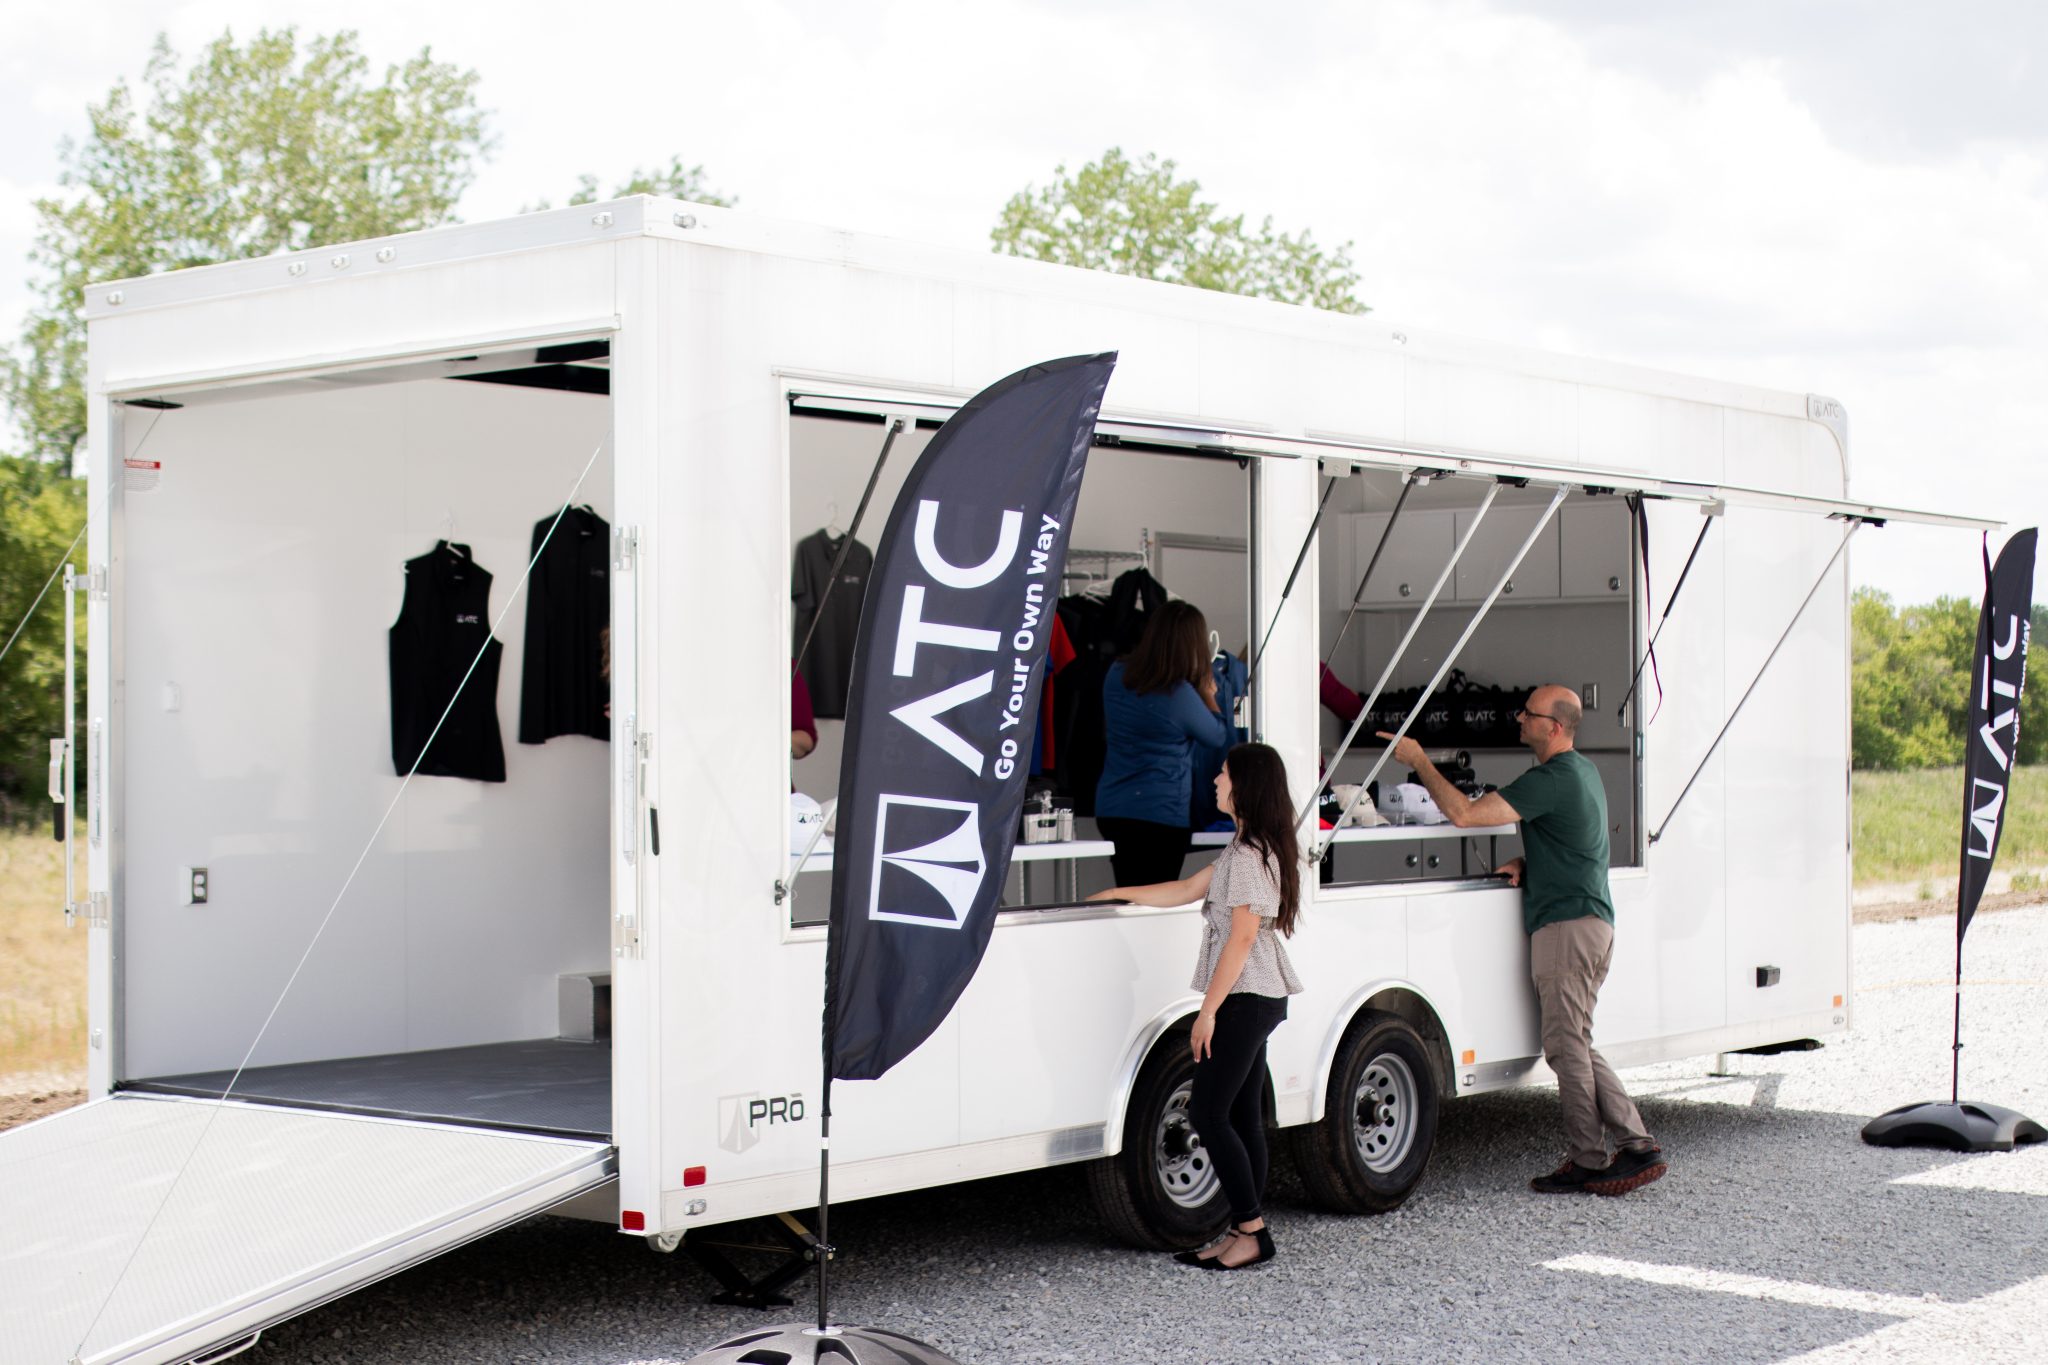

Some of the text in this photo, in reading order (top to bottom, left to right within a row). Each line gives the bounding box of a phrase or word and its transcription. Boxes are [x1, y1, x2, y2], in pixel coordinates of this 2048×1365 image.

[1823, 402, 1839, 419] ATC
[464, 615, 479, 624] ATC
[889, 499, 1023, 777] ATC
[994, 513, 1061, 780] Go Your Own Way
[1430, 711, 1449, 721] ATC
[1475, 711, 1496, 721] ATC
